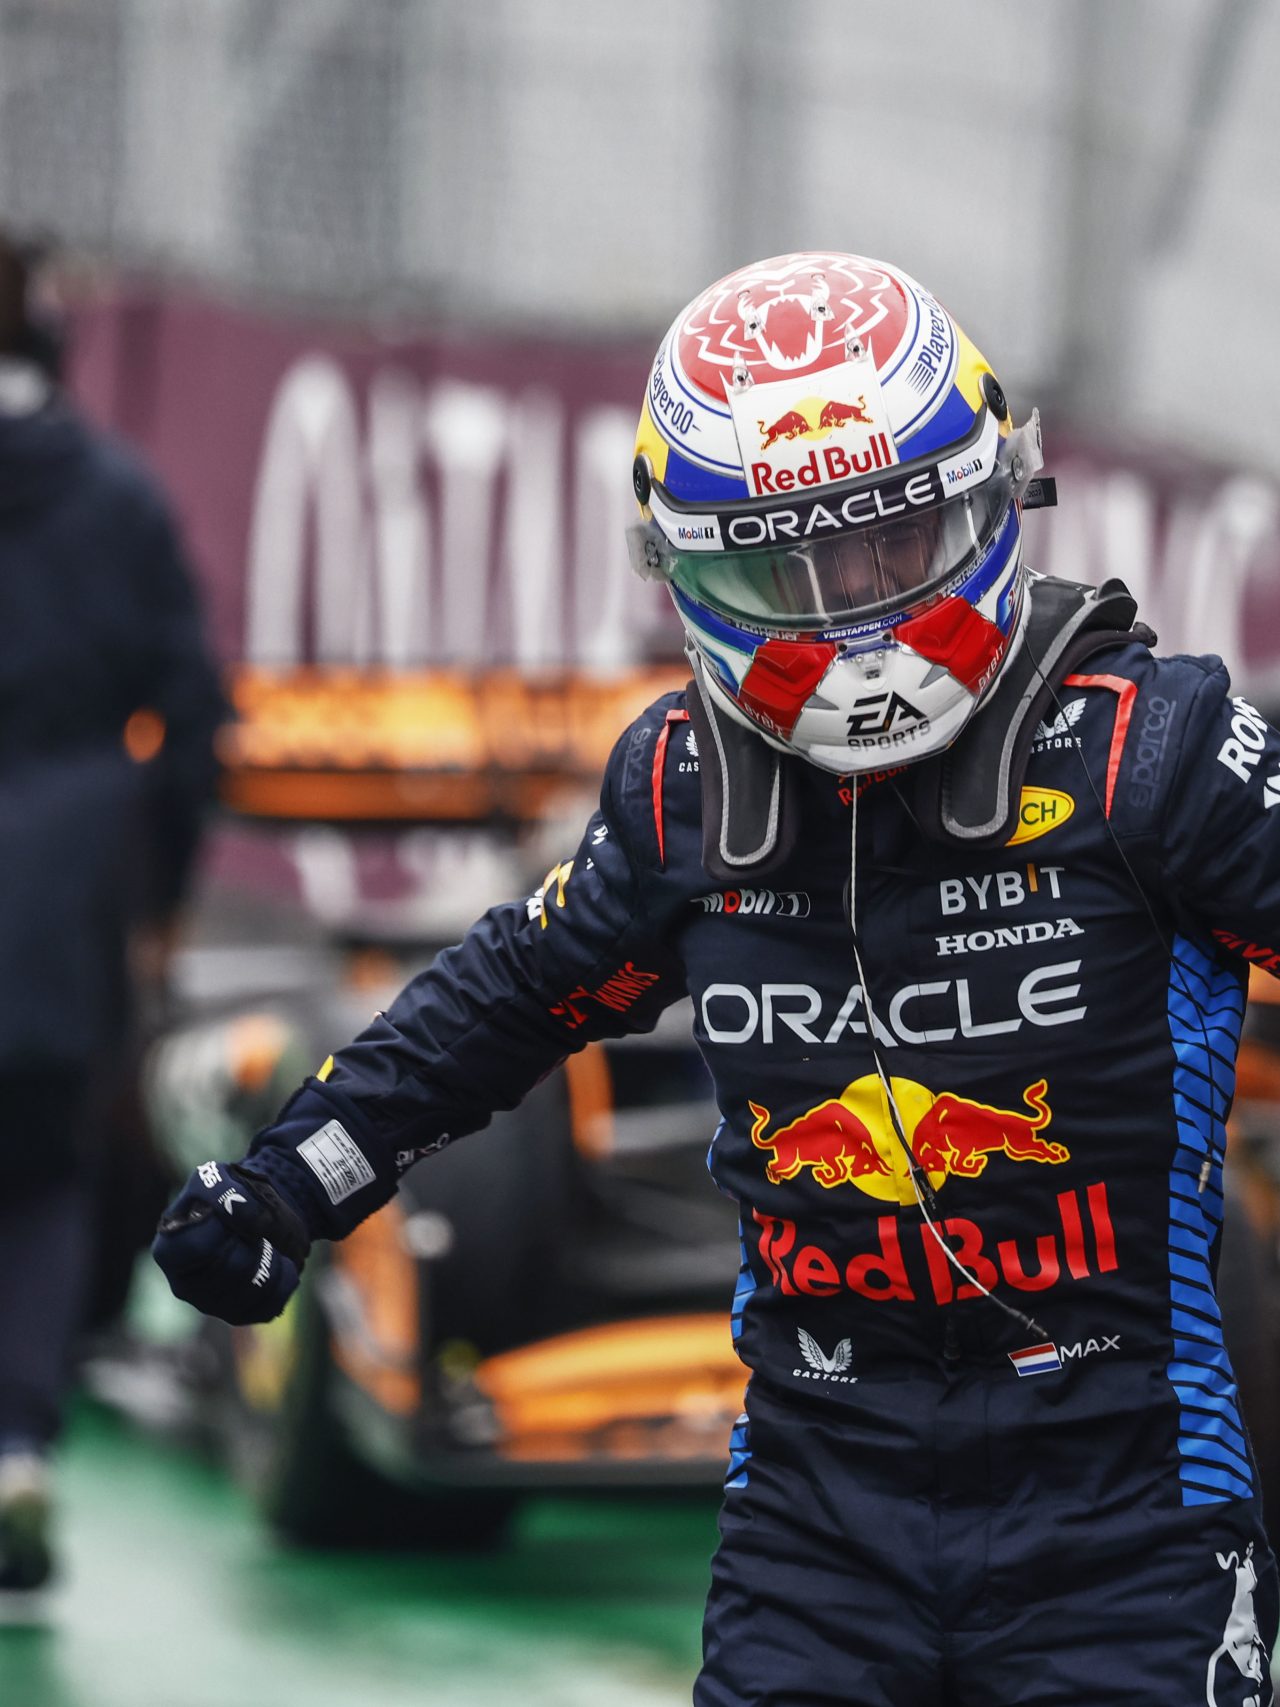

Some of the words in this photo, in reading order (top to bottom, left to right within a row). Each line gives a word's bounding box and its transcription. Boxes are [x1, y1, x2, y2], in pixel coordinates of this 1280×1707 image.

[751, 449, 821, 496] Red
[823, 432, 892, 481] Bull
[945, 463, 974, 484] Mobil
[728, 472, 937, 546] ORACLE
[678, 526, 704, 540] Mobil
[823, 613, 902, 641] VERSTAPPEN.COM
[846, 690, 928, 736] EA
[847, 719, 931, 752] SPORTS
[940, 863, 1065, 916] BYBIT
[935, 917, 1084, 957] HONDA
[702, 960, 1088, 1048] ORACLE
[752, 1205, 916, 1301] Red
[919, 1182, 1119, 1306] Bull
[1059, 1335, 1121, 1363] MAX
[792, 1368, 858, 1384] CASTORE
